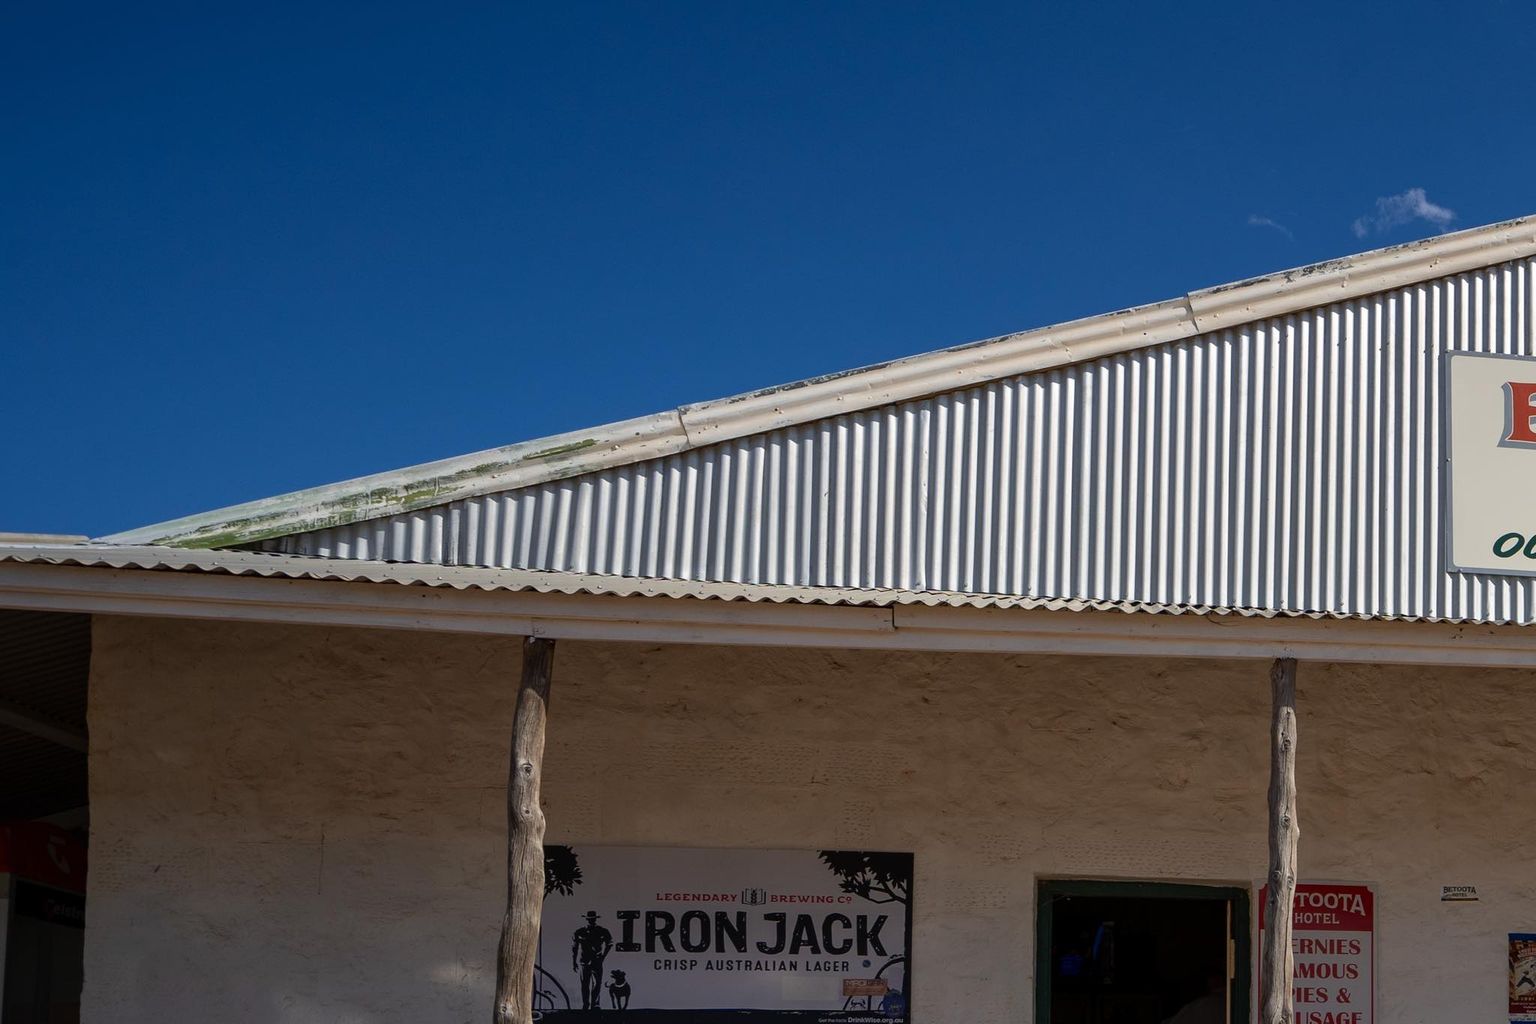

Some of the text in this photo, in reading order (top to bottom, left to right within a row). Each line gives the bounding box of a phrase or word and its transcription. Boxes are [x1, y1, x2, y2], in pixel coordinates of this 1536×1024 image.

[1443, 886, 1476, 894] BETOOTA
[656, 893, 738, 903] LEGENDARY
[771, 894, 834, 904] BREWING
[1293, 892, 1366, 917] TOOTA
[1294, 912, 1340, 924] HOTEL
[615, 910, 888, 957] IRON JACK
[1292, 938, 1361, 955] ERNIES
[654, 959, 850, 972] CRISP AUSTRALIAN LAGER
[1292, 987, 1351, 1003] IES &
